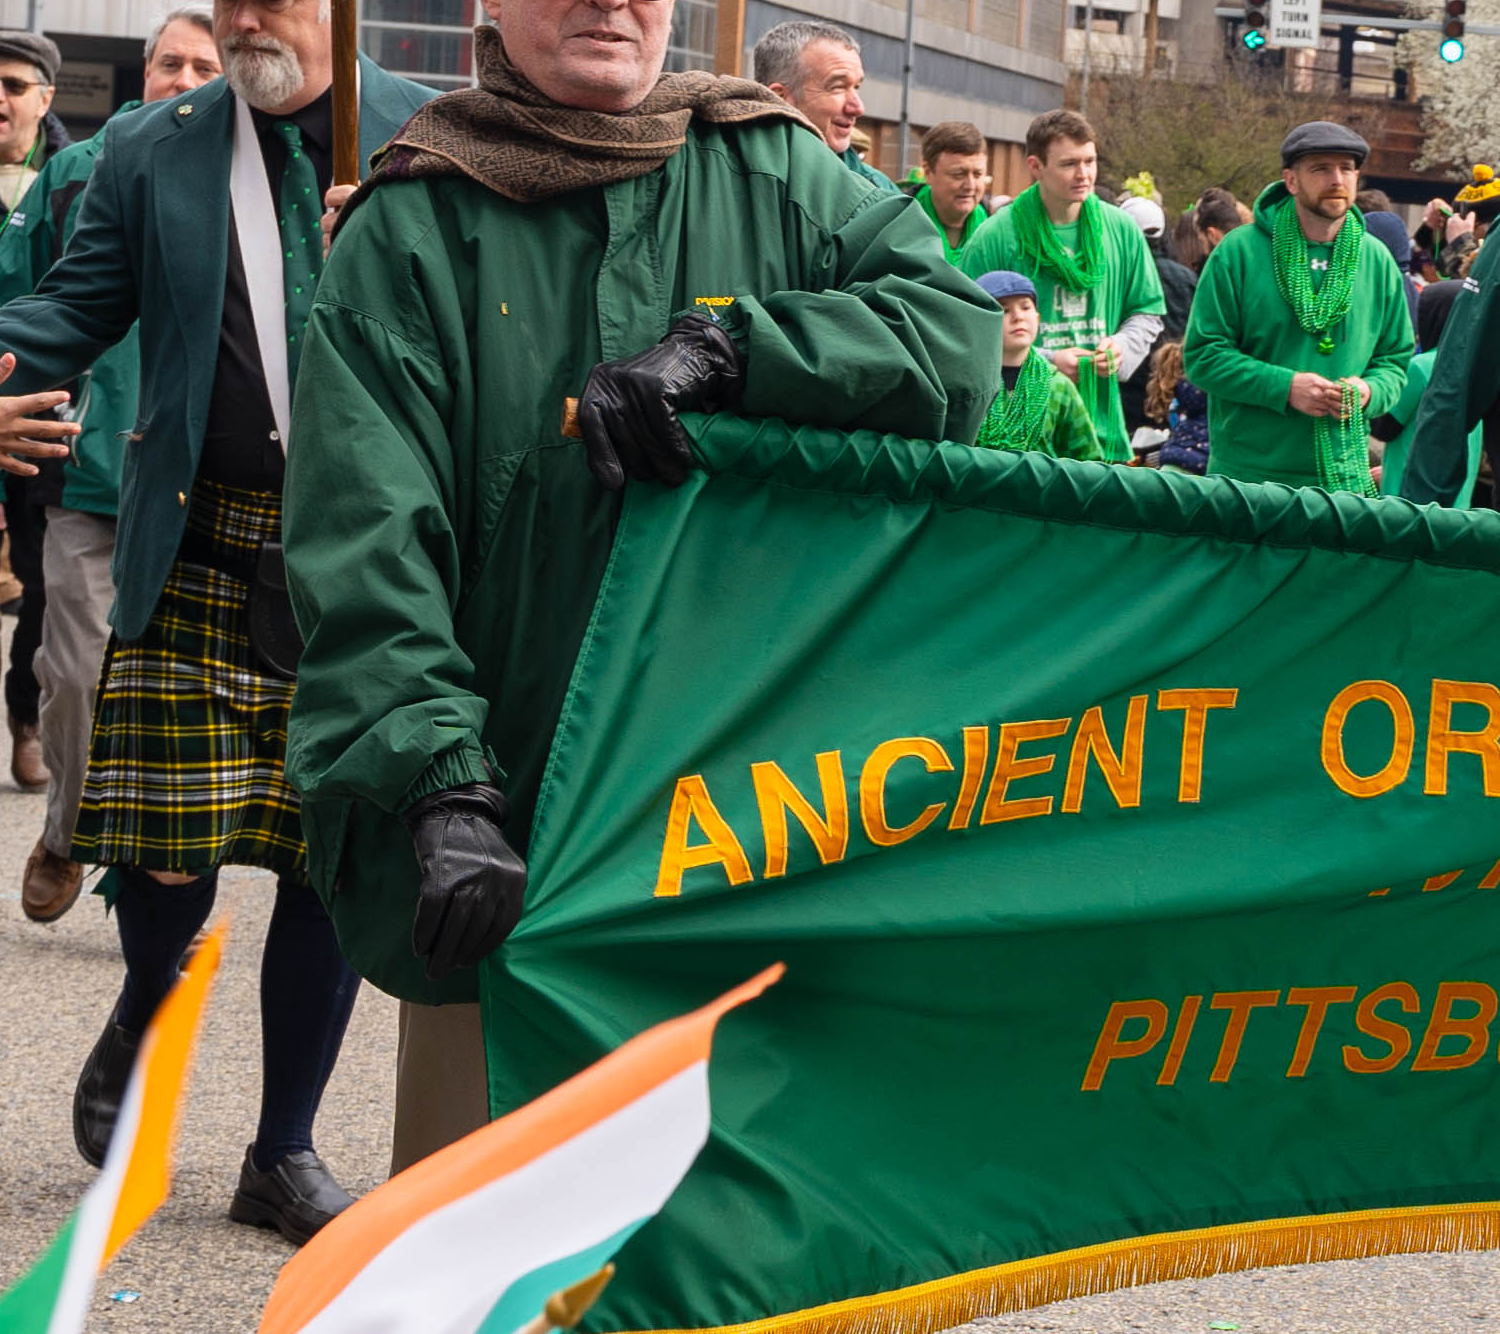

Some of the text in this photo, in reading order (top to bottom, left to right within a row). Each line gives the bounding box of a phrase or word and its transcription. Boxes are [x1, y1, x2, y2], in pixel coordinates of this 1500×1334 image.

[1282, 11, 1309, 23] TURN
[1275, 28, 1313, 41] SIGNAL
[653, 687, 1239, 898] ANCIENT
